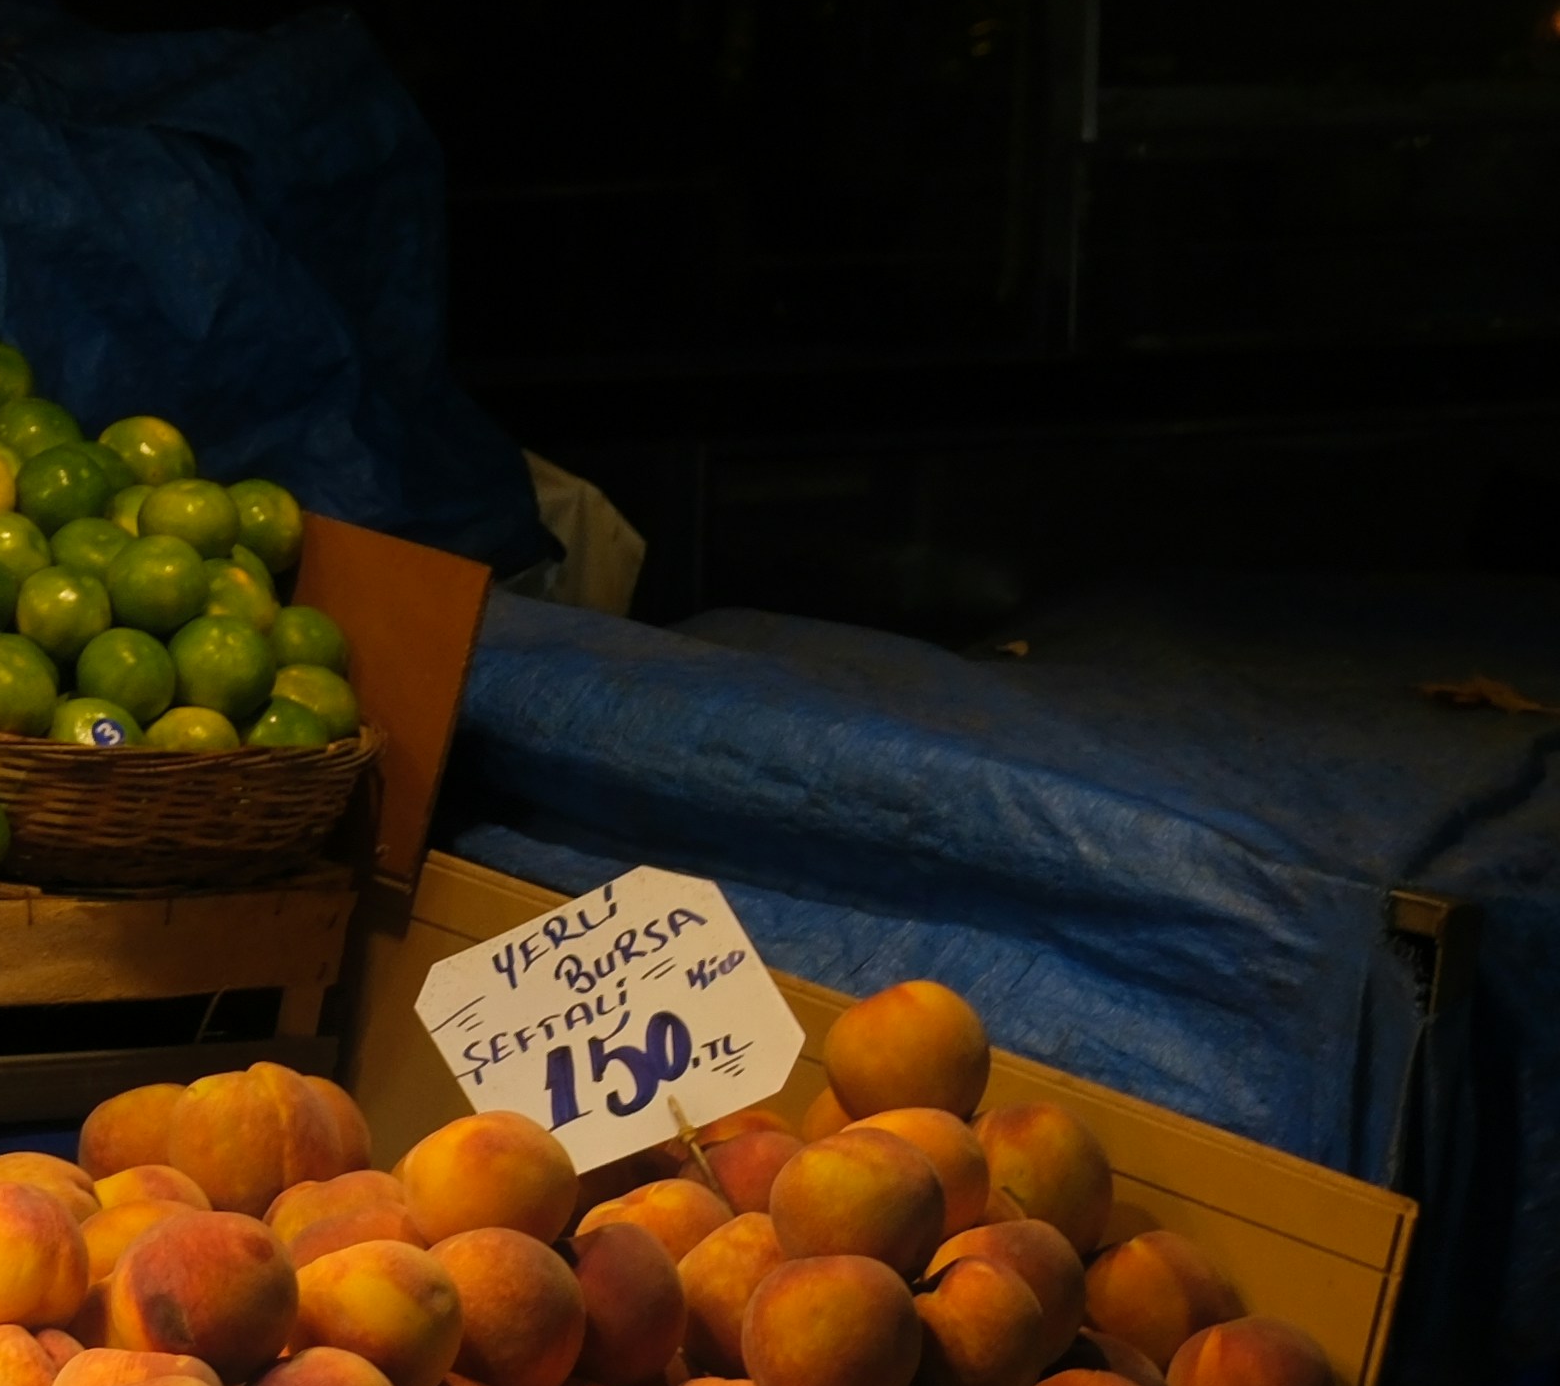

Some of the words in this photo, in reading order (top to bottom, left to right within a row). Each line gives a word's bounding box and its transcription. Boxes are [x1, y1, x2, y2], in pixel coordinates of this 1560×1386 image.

[492, 882, 618, 990] YERLİ
[554, 907, 708, 994] BURSA
[544, 1010, 692, 1133] 150
